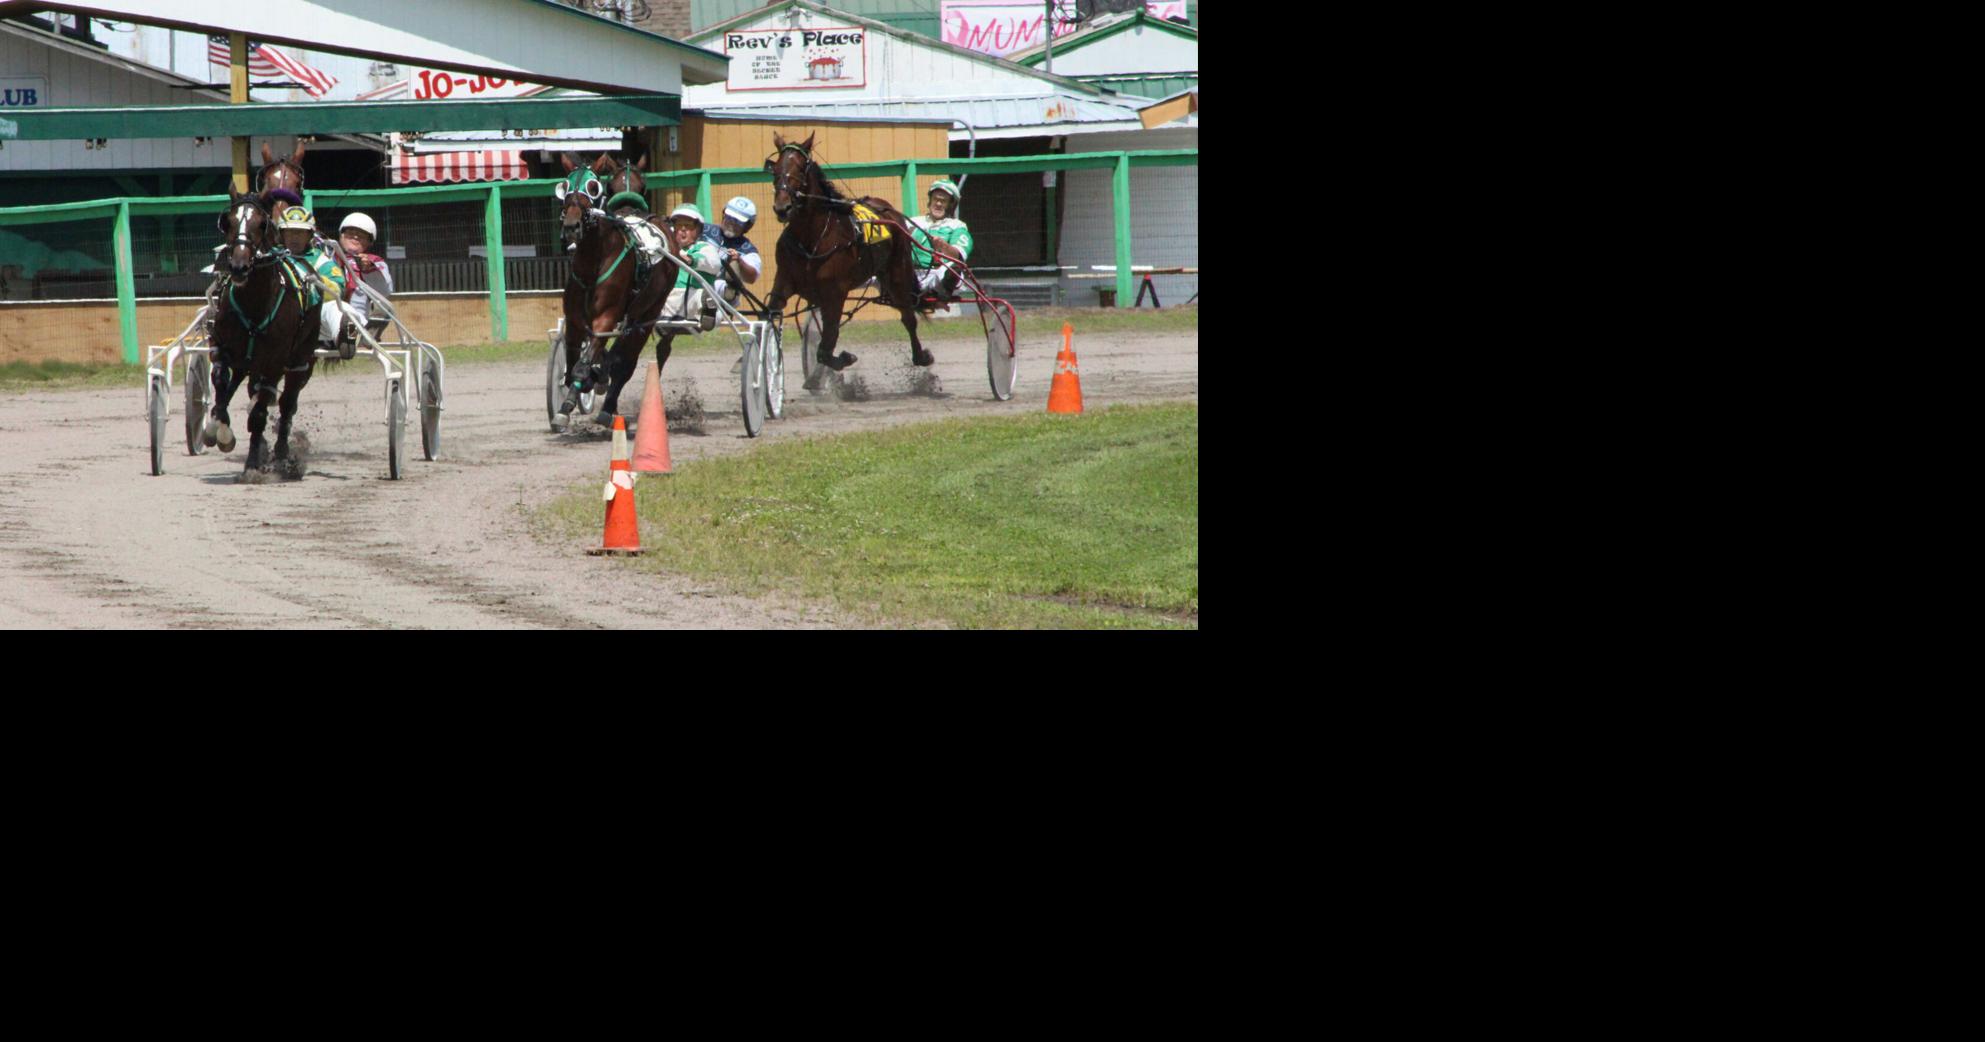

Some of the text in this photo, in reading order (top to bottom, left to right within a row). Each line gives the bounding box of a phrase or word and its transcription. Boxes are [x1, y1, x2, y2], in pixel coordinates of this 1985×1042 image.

[727, 31, 863, 49] Rev's Place
[0, 88, 38, 106] UB
